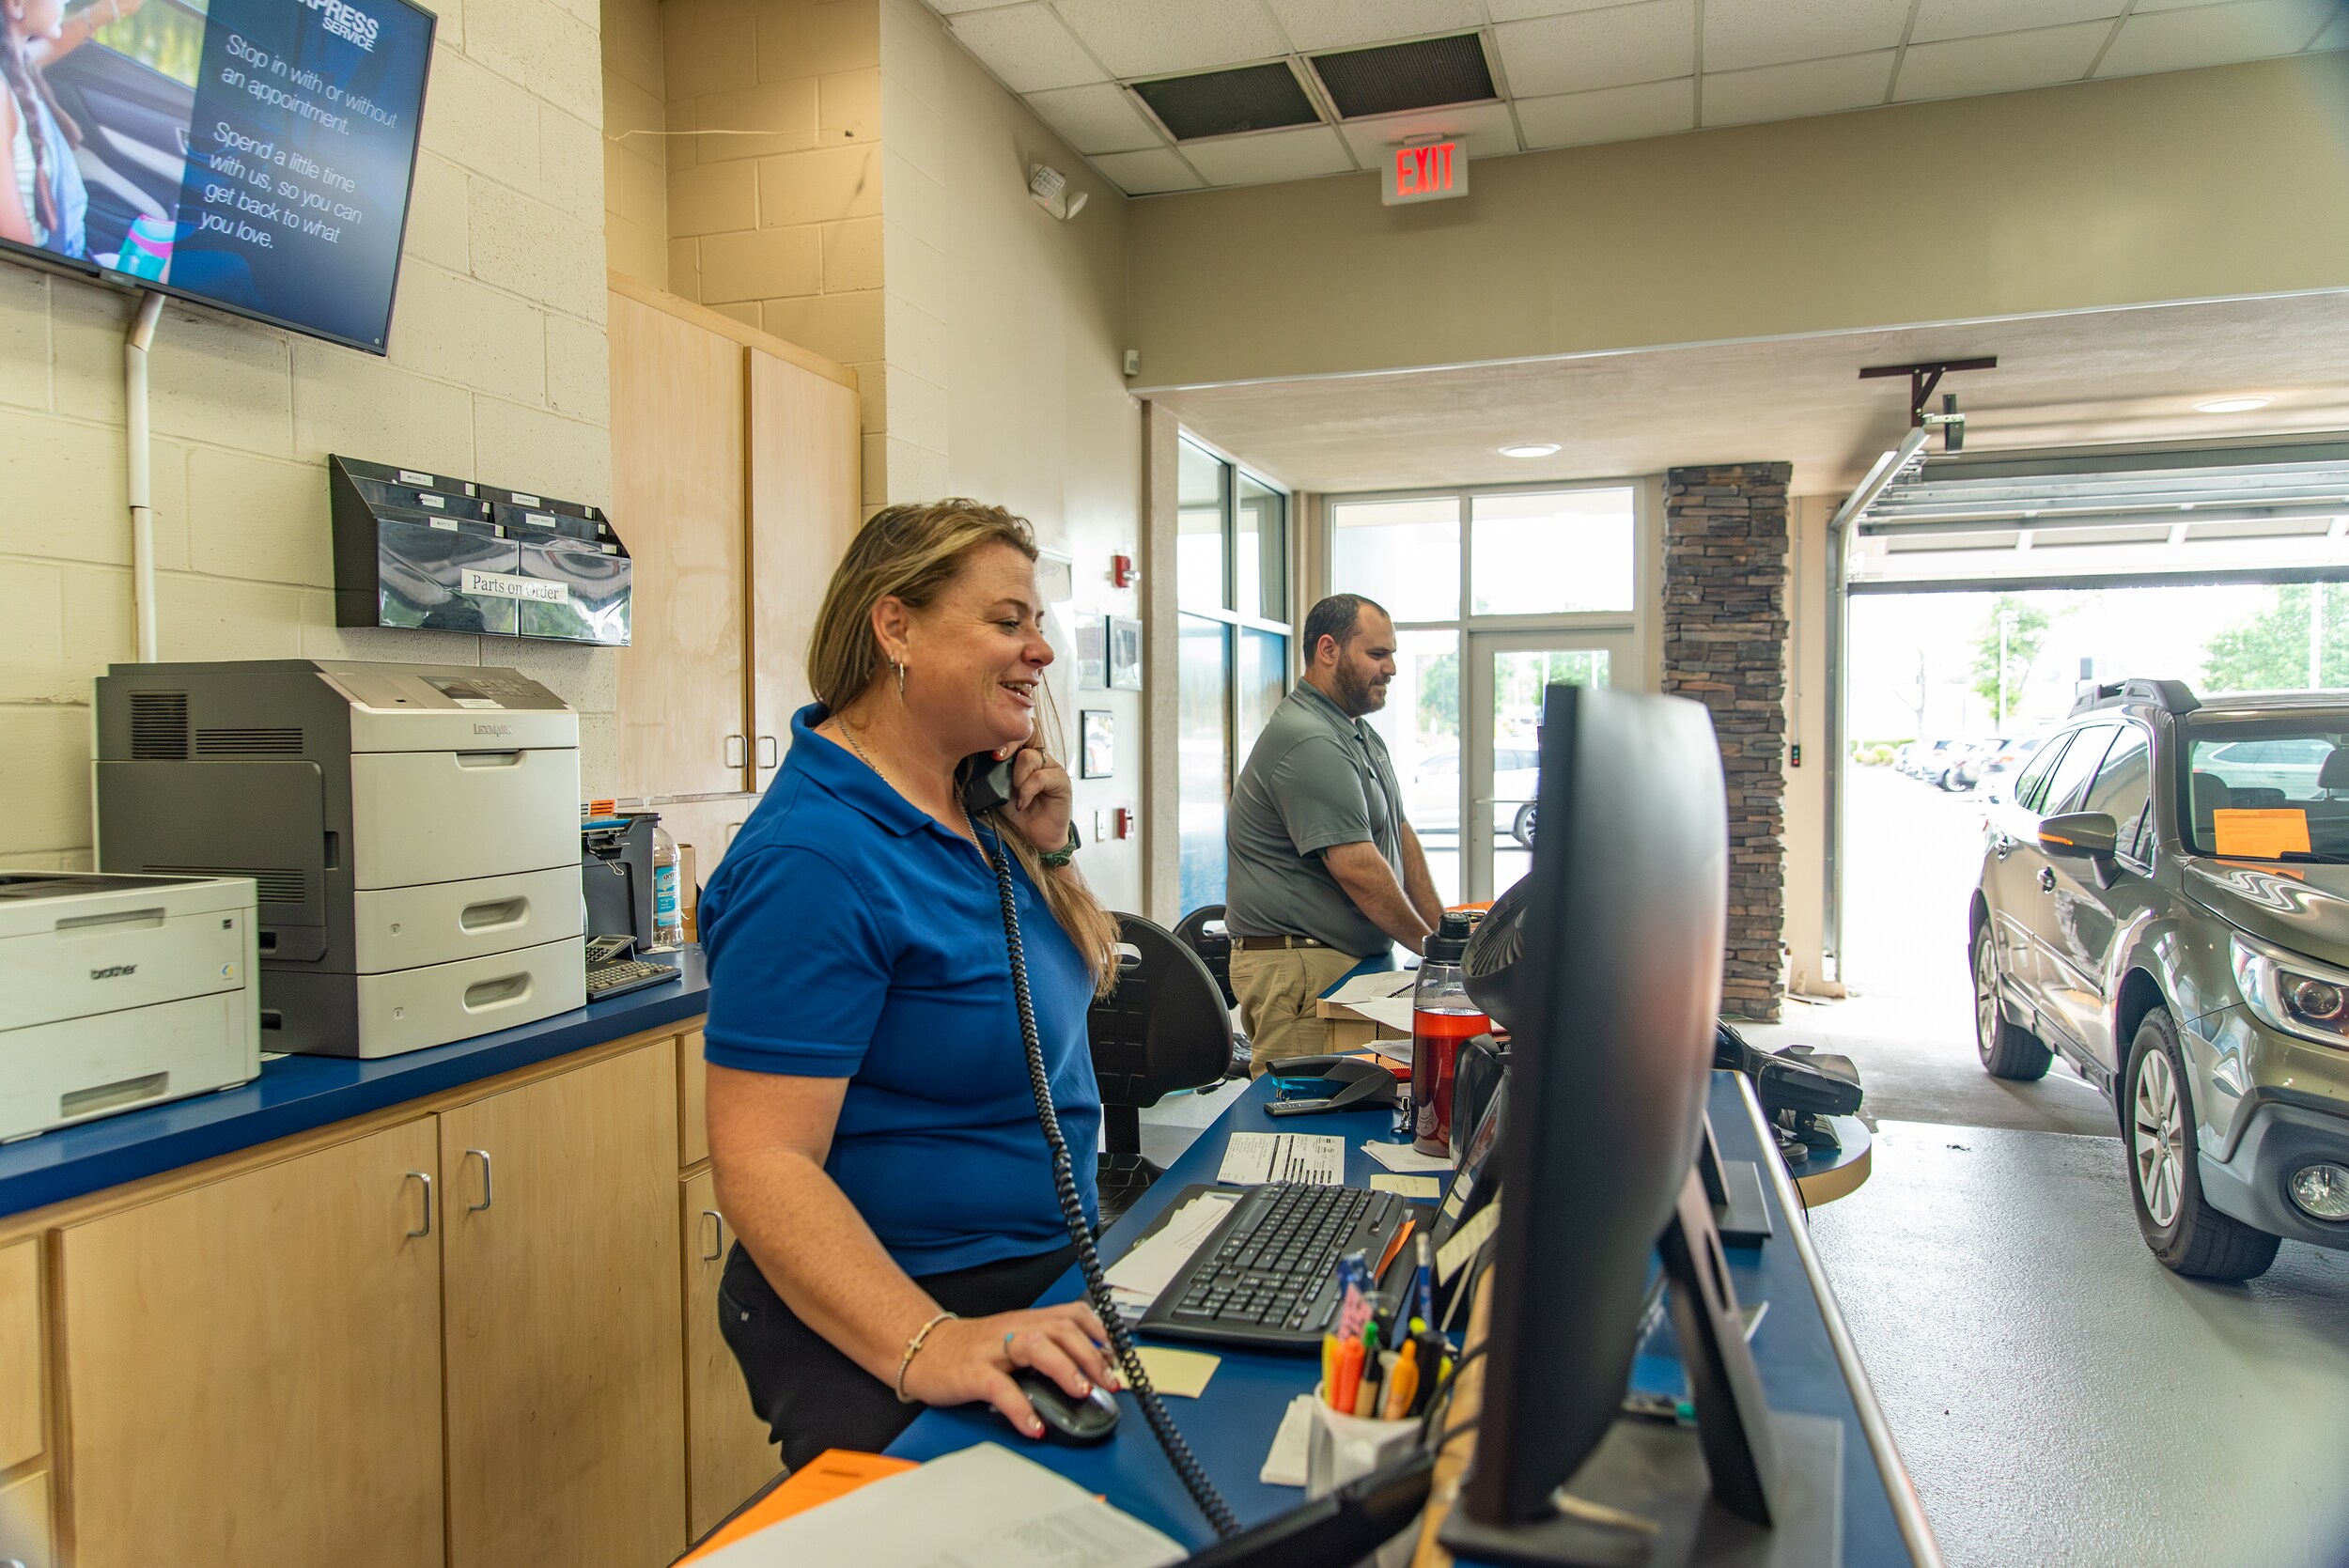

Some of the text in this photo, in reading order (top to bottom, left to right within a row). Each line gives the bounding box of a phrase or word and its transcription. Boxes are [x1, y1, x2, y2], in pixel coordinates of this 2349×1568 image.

[321, 16, 375, 53] SERVICE
[221, 68, 350, 136] an appointment.
[226, 34, 397, 129] Stop in with or without
[212, 121, 355, 194] Spend a little time
[1396, 142, 1455, 195] EXIT
[204, 183, 341, 243] get back to what
[210, 154, 363, 225] with us, so you can
[198, 211, 273, 249] you love.
[473, 574, 559, 600] Parts on Order
[90, 963, 138, 980] brother
